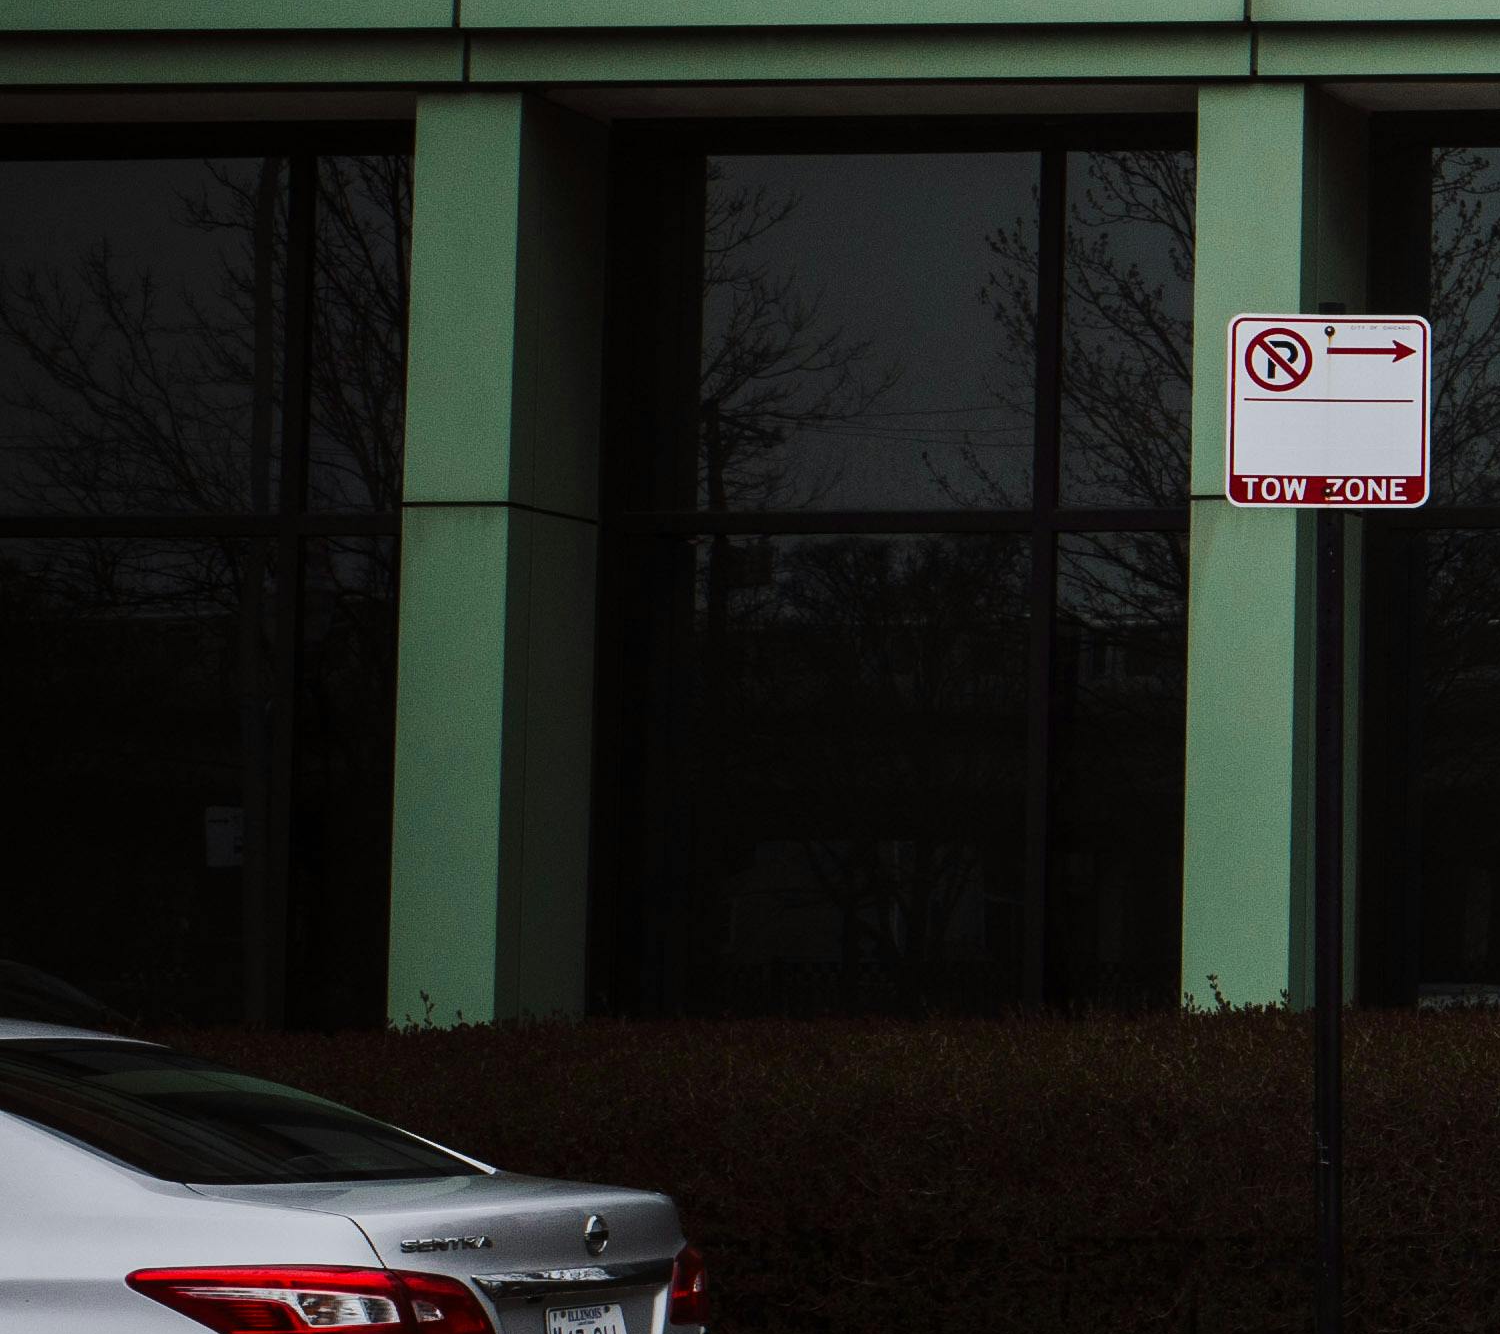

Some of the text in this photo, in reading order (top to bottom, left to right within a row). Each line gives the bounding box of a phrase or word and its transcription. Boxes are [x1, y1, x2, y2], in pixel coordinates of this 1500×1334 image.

[1241, 477, 1408, 502] TOW ZONE
[567, 1307, 602, 1322] ILLINOIS
